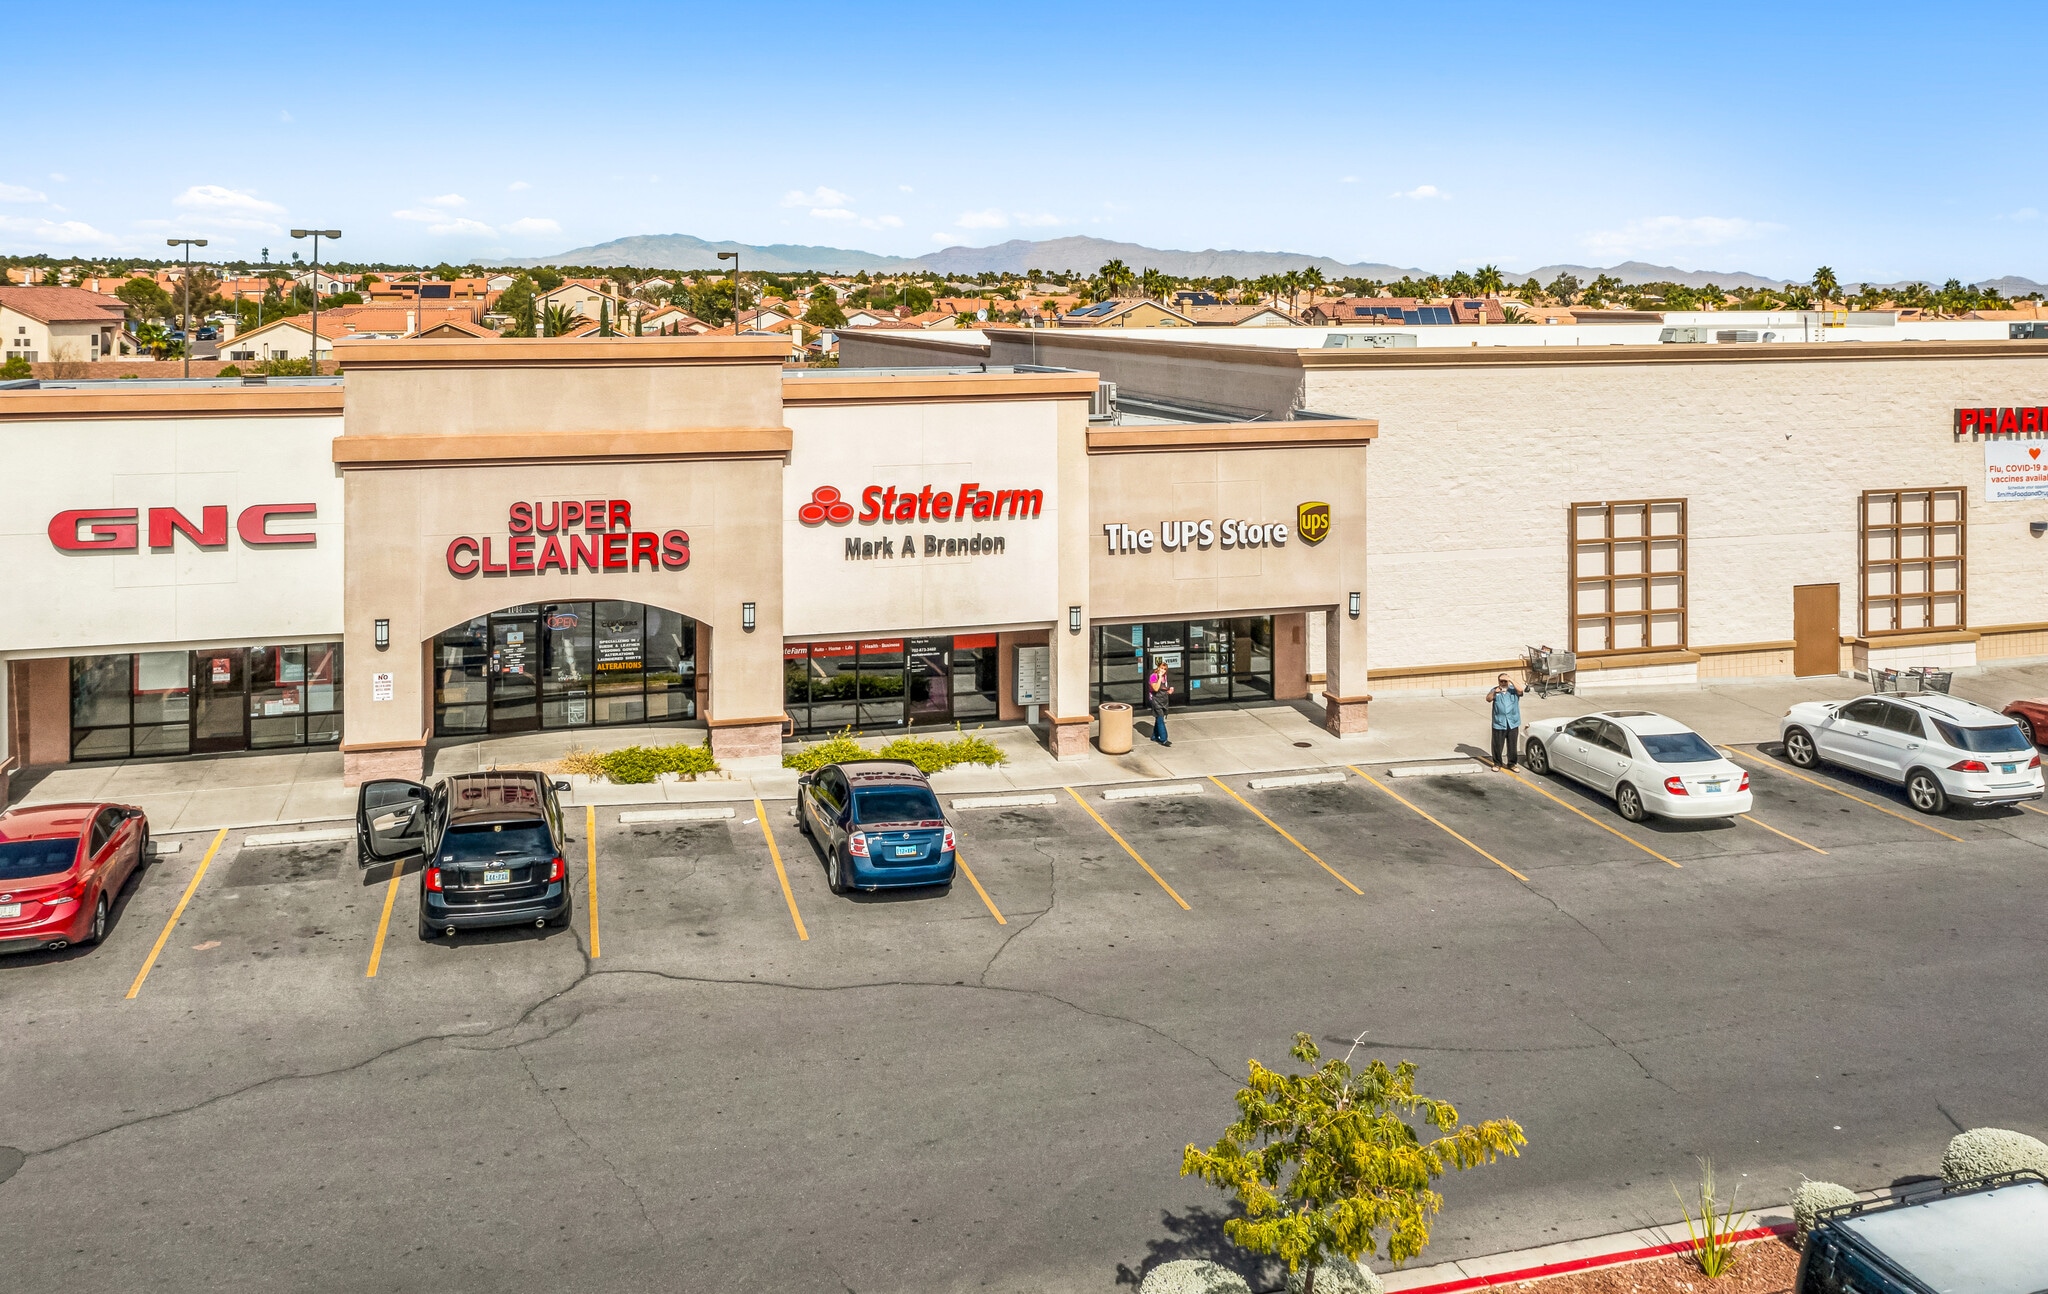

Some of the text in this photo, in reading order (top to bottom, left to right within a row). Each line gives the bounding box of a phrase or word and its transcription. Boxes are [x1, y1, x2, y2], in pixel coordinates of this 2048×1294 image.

[1958, 407, 2048, 434] PHAR
[1989, 465, 2003, 473] Flu,
[2005, 464, 2041, 472] COVID-19
[48, 503, 316, 550] GNC
[509, 500, 632, 533] SUPER
[1301, 512, 1329, 536] ups
[845, 533, 1005, 557] Mark A Brandon
[1104, 519, 1289, 550] The UPS Store
[446, 529, 690, 575] CLEANERS
[548, 617, 578, 628] OPEN
[597, 662, 642, 670] ALTERATIONS
